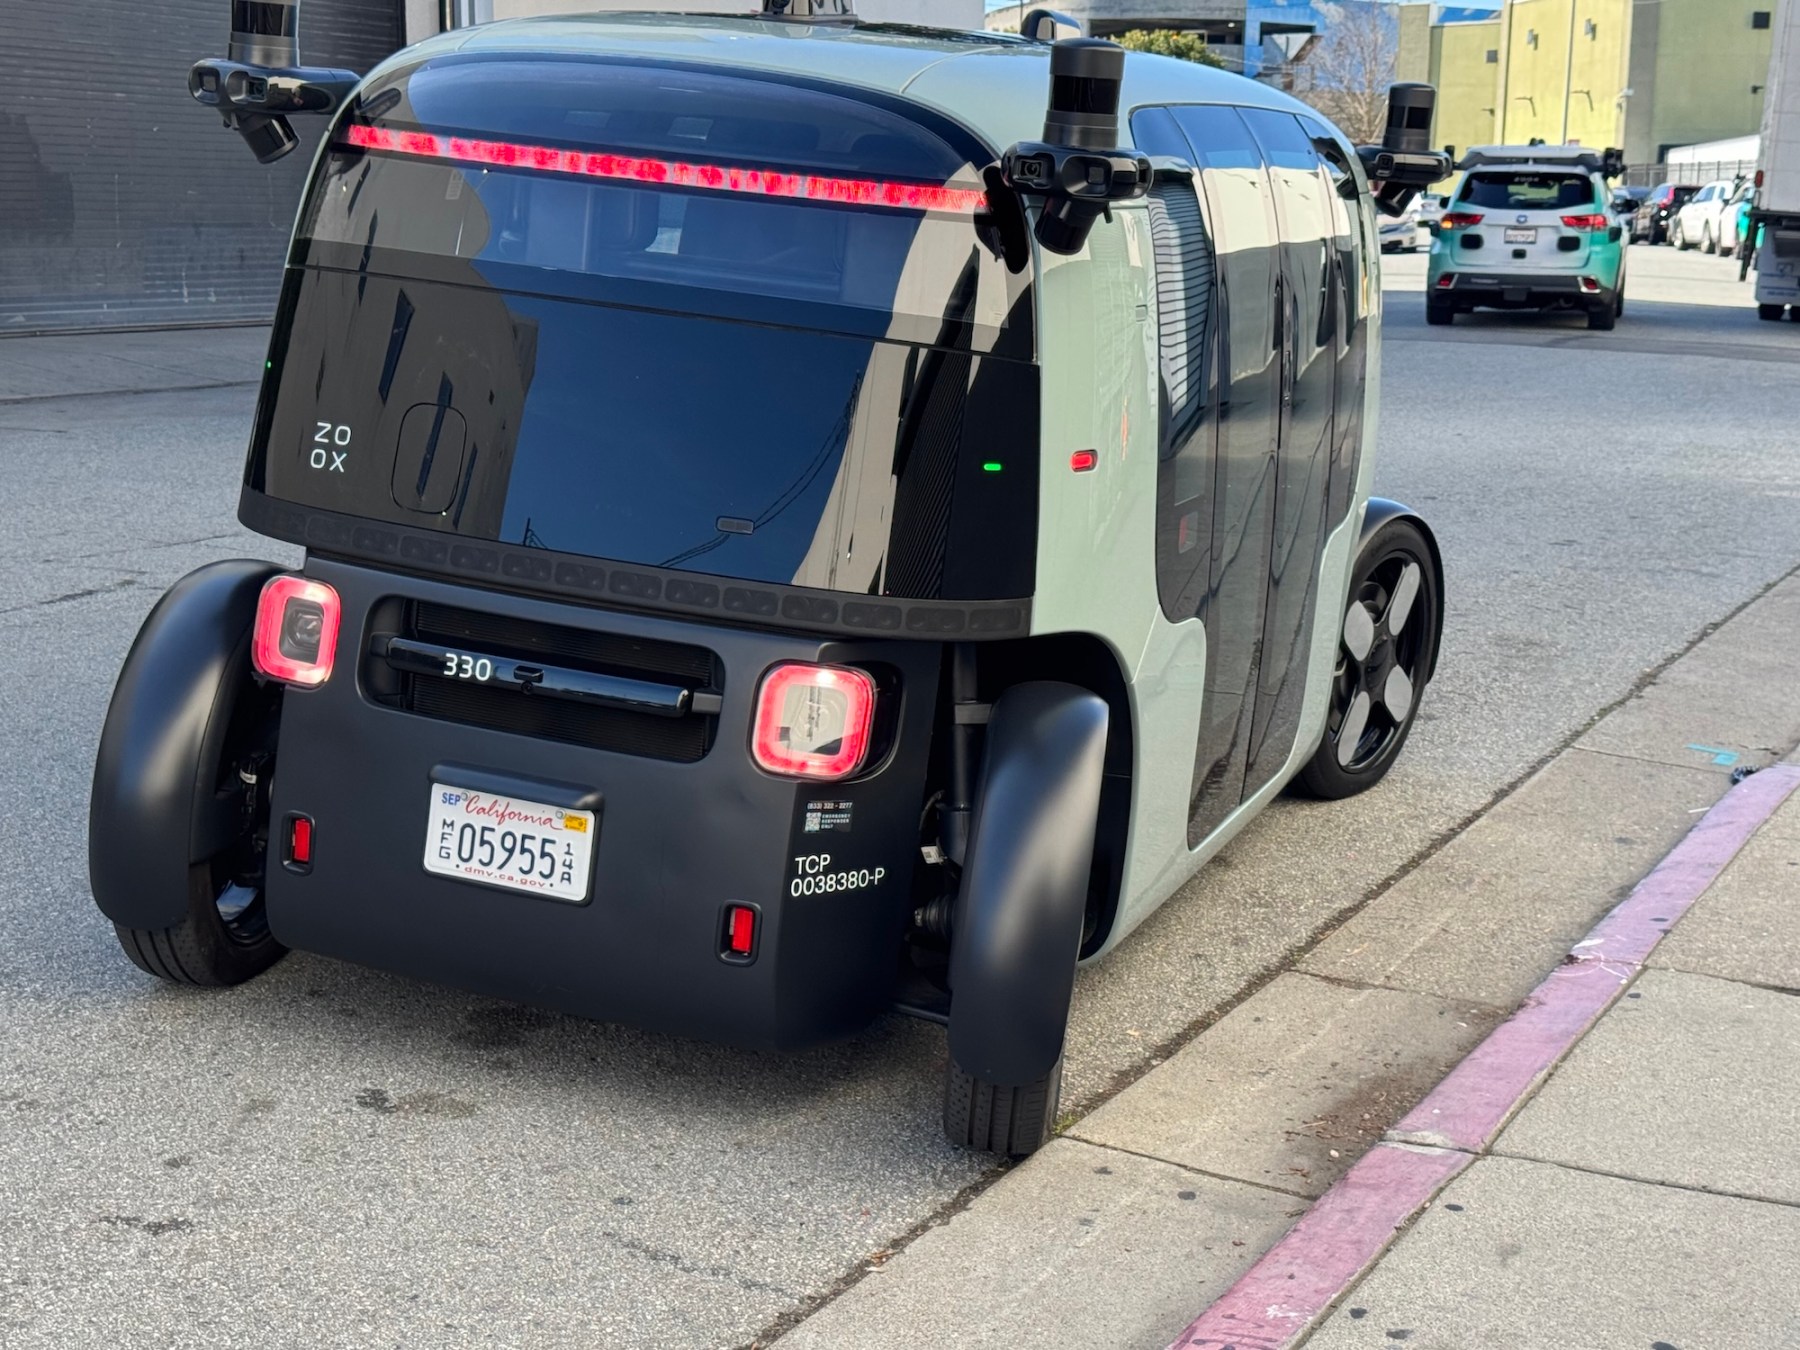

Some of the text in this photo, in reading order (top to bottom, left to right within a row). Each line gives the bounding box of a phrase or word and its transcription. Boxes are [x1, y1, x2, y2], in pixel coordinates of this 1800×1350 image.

[314, 421, 351, 445] ZO
[310, 448, 347, 473] OX
[443, 653, 491, 681] 330
[441, 792, 461, 806] SEP
[465, 795, 563, 830] California
[438, 818, 455, 860] MFG
[457, 823, 556, 880] 05955
[464, 865, 546, 888] dmv.ca.gov
[795, 854, 831, 875] TCP
[790, 867, 885, 897] 0038380-P
